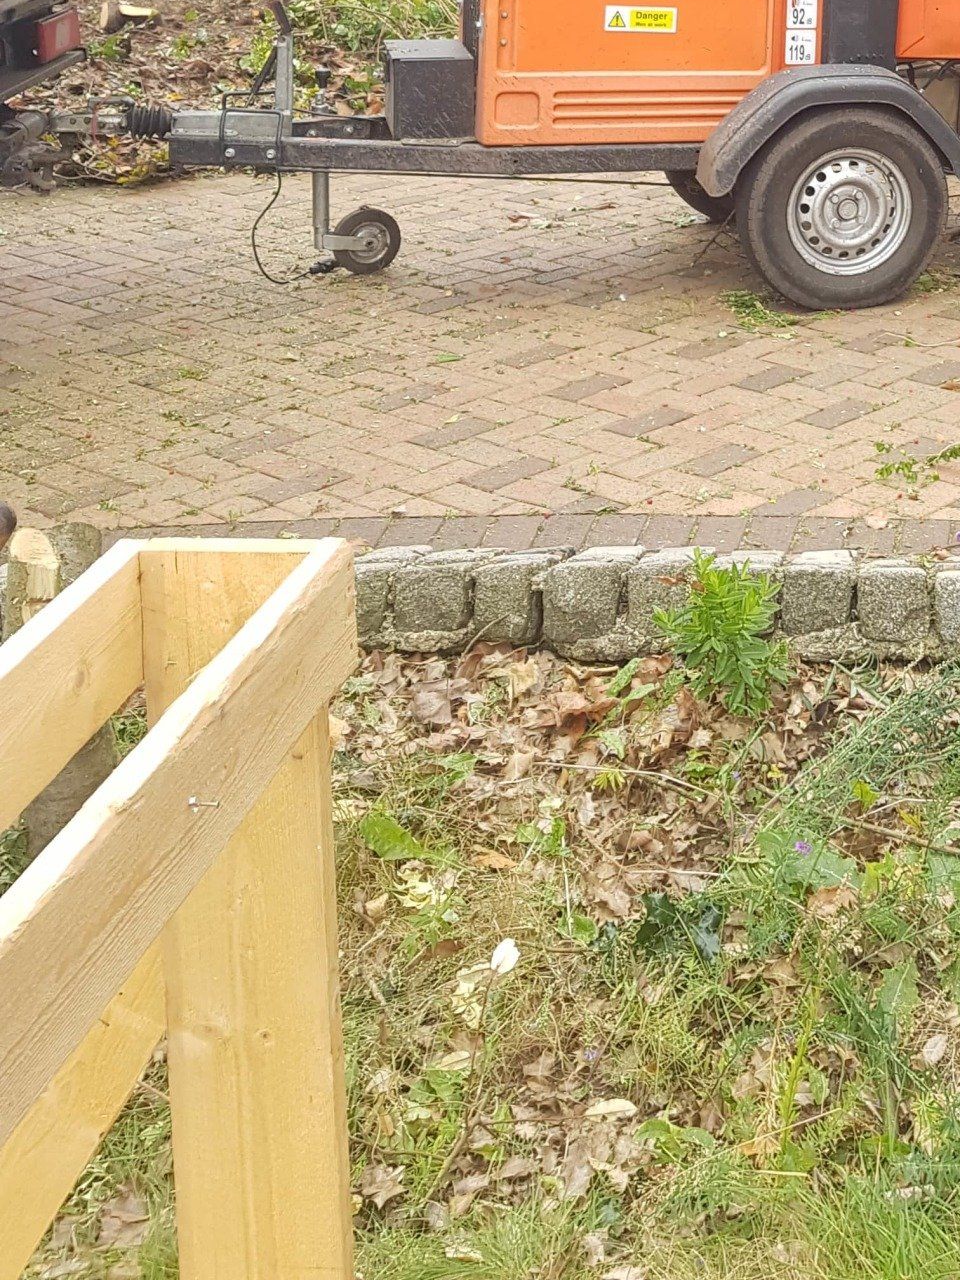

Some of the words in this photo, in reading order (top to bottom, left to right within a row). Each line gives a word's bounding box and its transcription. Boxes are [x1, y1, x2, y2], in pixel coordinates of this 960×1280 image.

[635, 11, 668, 22] Danger
[792, 8, 805, 25] 92
[789, 45, 805, 61] 119
